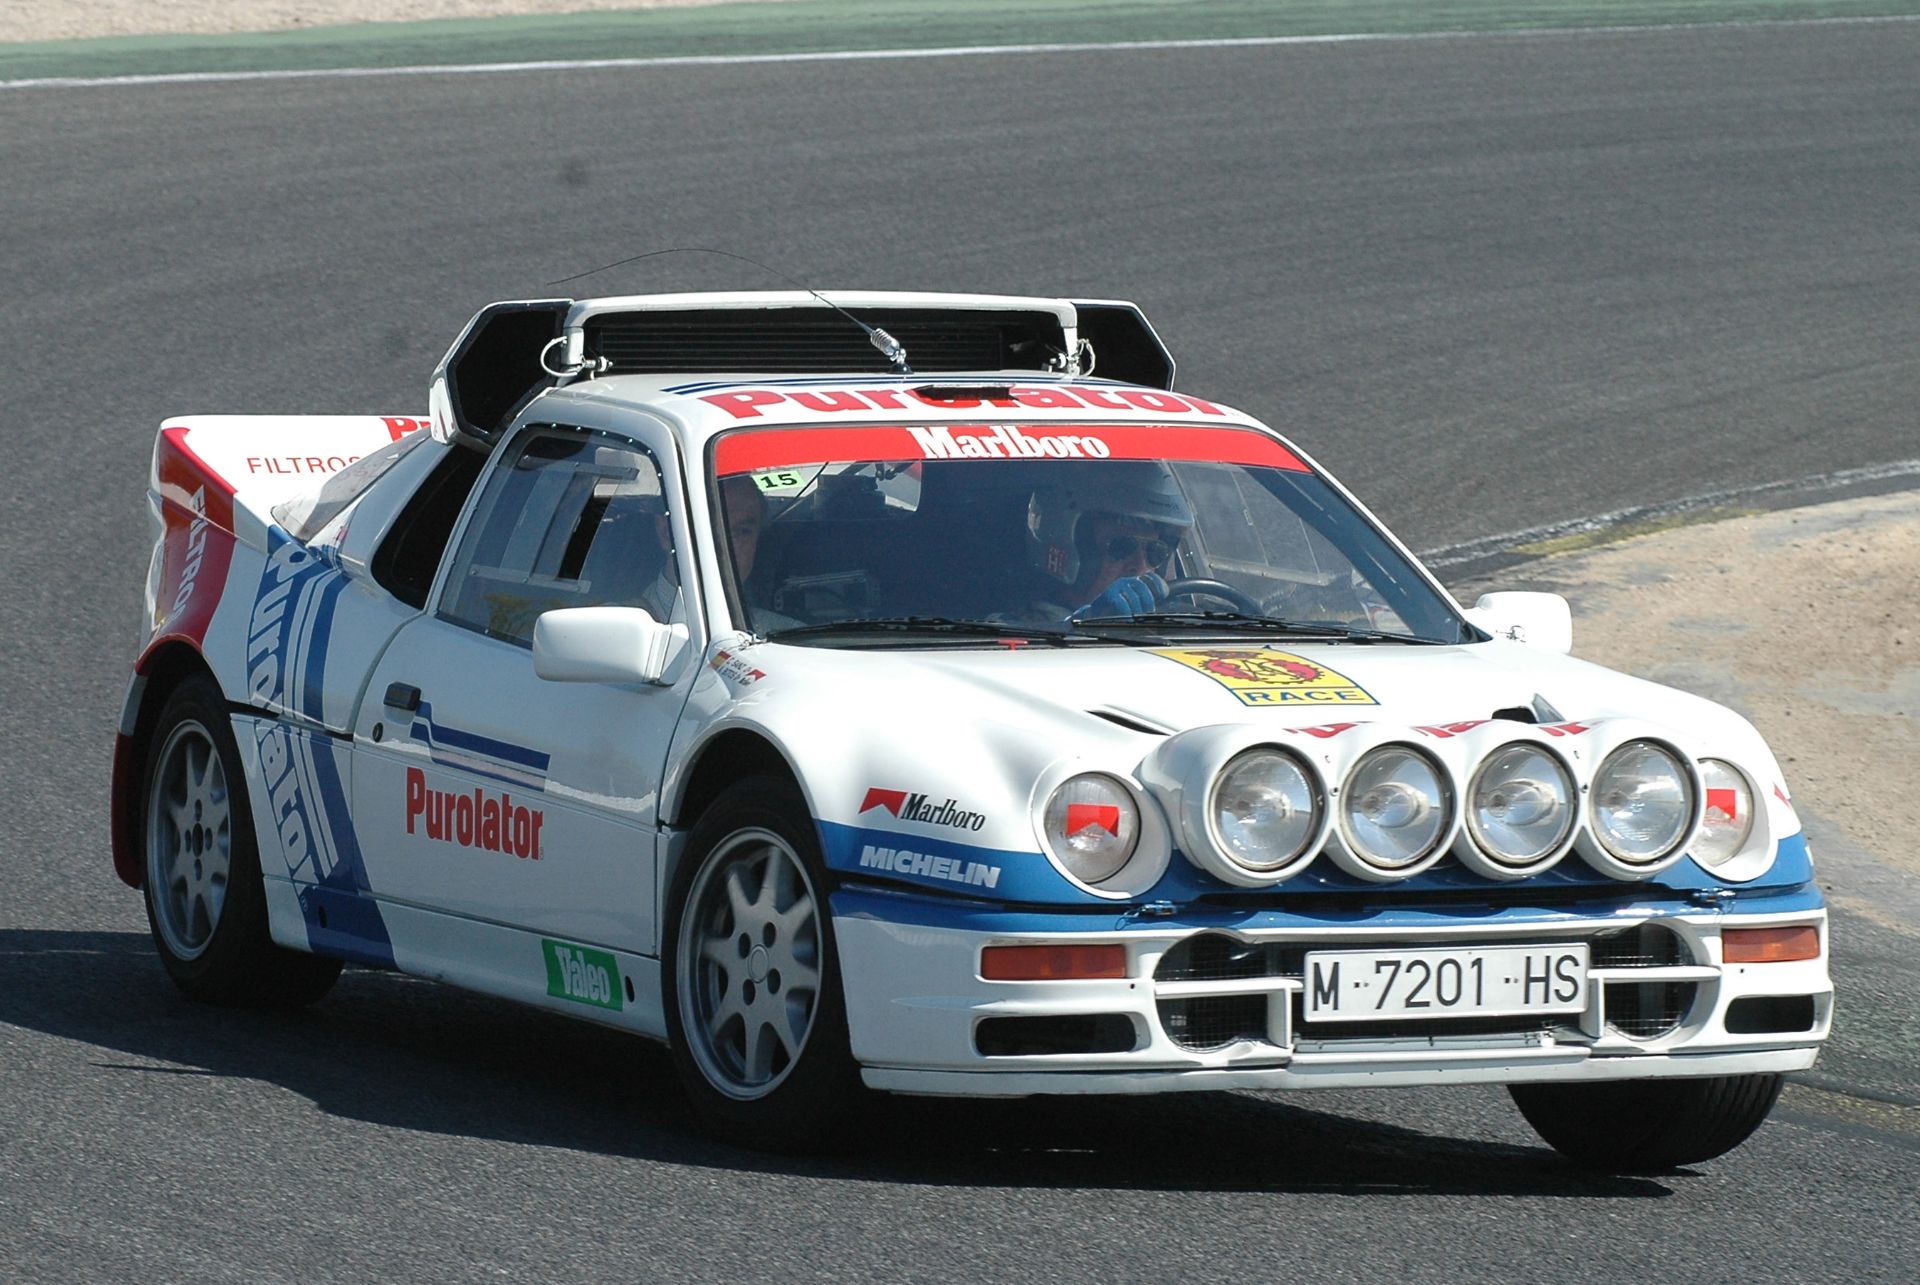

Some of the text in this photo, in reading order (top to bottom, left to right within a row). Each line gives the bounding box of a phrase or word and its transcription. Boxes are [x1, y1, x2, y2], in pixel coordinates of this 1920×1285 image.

[906, 425, 1111, 459] Marlboro
[760, 473, 798, 489] 15
[1243, 690, 1365, 703] RACE
[406, 767, 544, 861] Purolator
[901, 793, 987, 832] Marlboro
[859, 845, 1002, 889] MICHELIN
[554, 946, 612, 1004] Valeo
